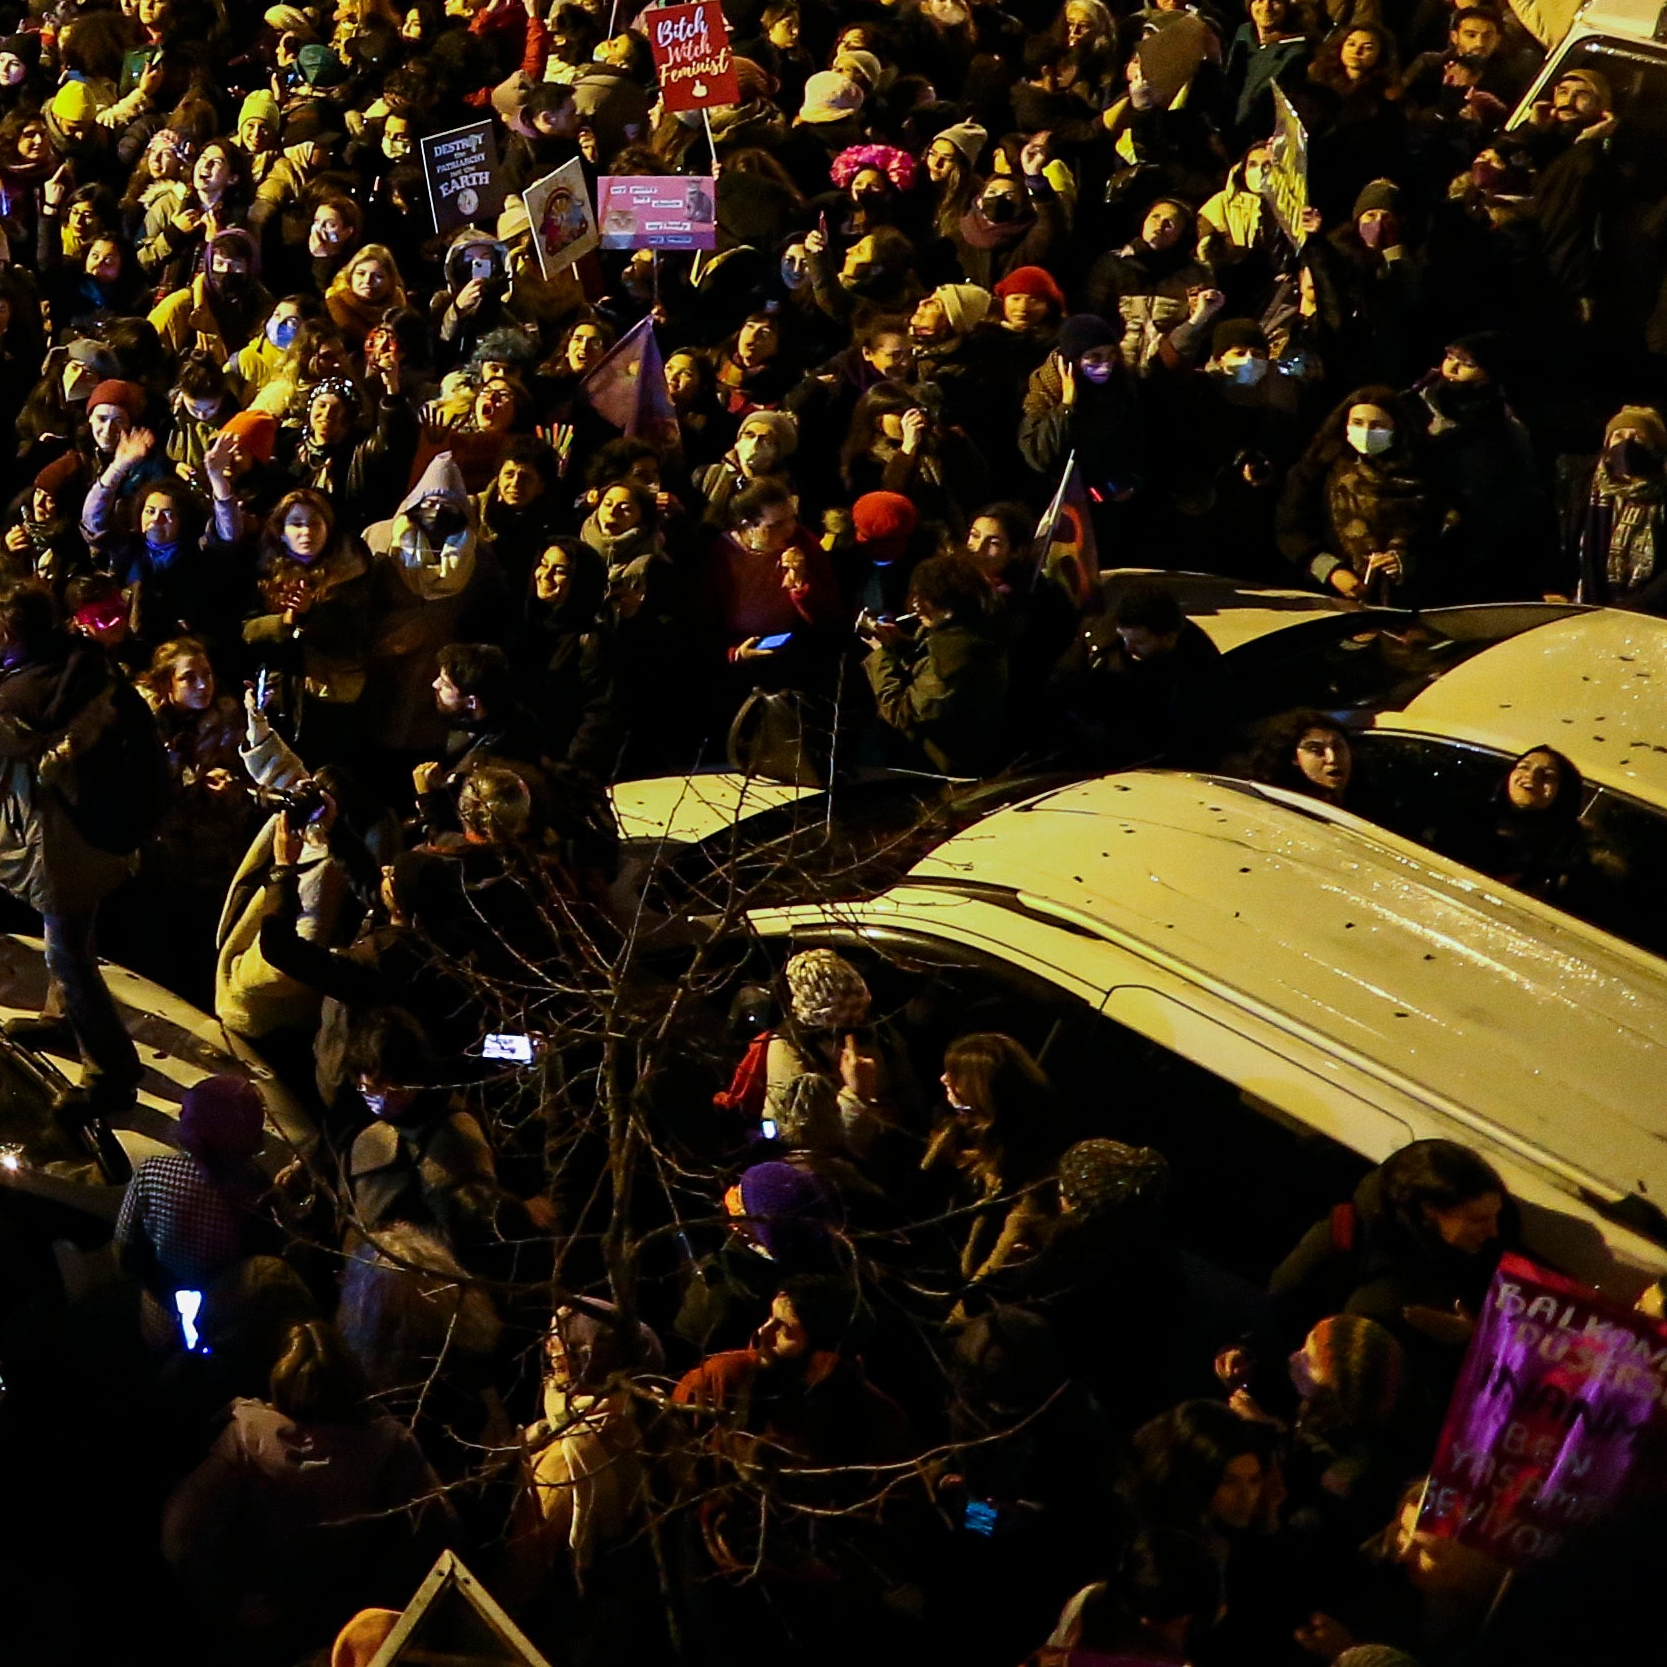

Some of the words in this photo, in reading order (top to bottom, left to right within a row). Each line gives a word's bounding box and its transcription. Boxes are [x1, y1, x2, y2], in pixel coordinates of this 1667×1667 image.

[657, 6, 708, 48] Bitch
[659, 47, 729, 87] Feminist
[433, 133, 484, 158] DESTROY
[439, 171, 490, 199] EARTH
